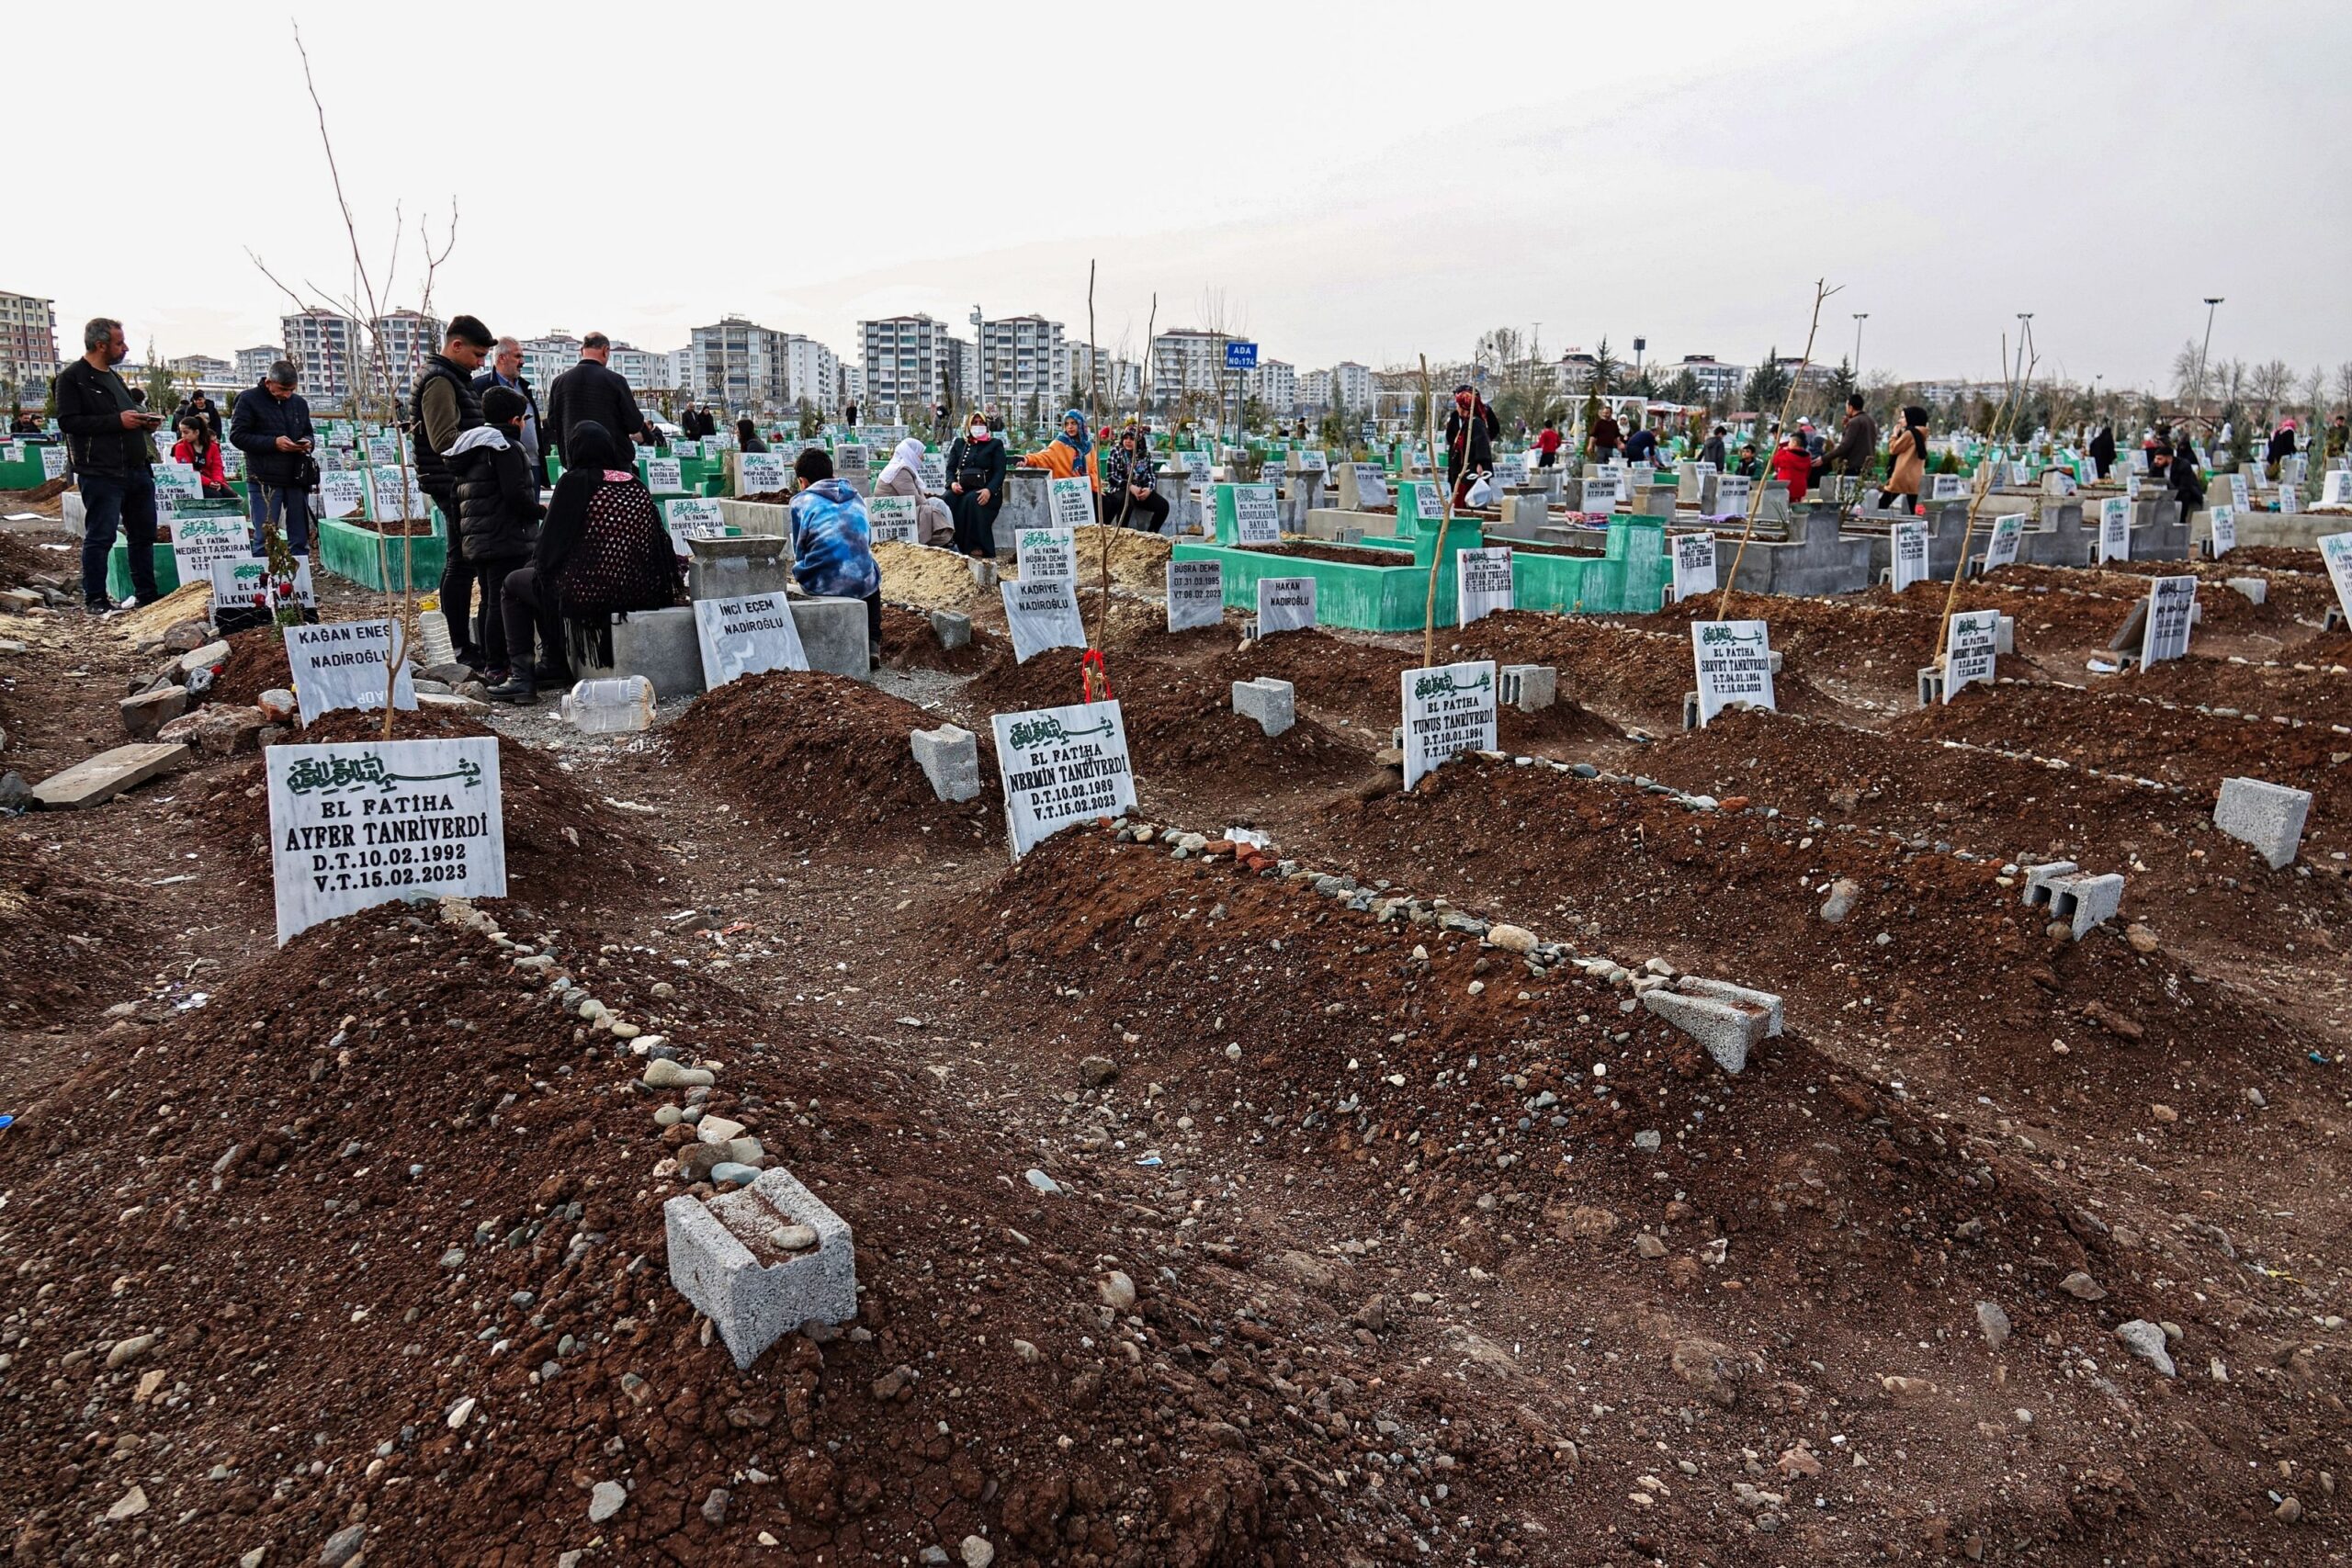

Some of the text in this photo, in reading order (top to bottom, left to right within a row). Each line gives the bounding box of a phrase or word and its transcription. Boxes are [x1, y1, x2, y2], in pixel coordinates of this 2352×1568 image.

[1234, 346, 1251, 355] ADA
[671, 522, 692, 530] ZERİFE
[207, 536, 230, 545] FATİHA
[175, 544, 251, 556] NEDRET TAŞKIRAN
[1025, 554, 1068, 563] BÜŞRA DEMİR
[1174, 563, 1220, 573] BÜŞRA DEMİR
[1021, 582, 1058, 595] KADRİYE
[1275, 582, 1300, 592] HAKAN
[719, 599, 775, 616] İNCİ EÇEM
[1019, 599, 1069, 611] NADİROĞLU
[1270, 596, 1309, 606] NADİROĞLU
[724, 617, 784, 635] NADİROĞLU
[299, 627, 351, 644] KAĞAN
[1713, 647, 1755, 657] EL FATİHA
[1702, 657, 1770, 671] SERVET TANRİVERDİ
[1428, 696, 1479, 713] EL FATİHA
[1413, 707, 1493, 734] YUNUS TANRİVERDİ
[1424, 728, 1483, 746] D.T.10.01.1994
[1031, 743, 1102, 766] EL FATİHA
[1424, 739, 1484, 759] V.T.15.022023
[1009, 754, 1127, 793] NERMİN TANRİVERDİ
[1031, 779, 1114, 806] D.T.10.02.1989
[322, 794, 454, 818] EL FATİHA
[1034, 794, 1116, 821] V.T.15.02.2023
[286, 812, 488, 852] AYFER TANRİVERDİ
[313, 843, 466, 871] D.T.10.02.1992
[314, 864, 467, 892] V.T.15.02.2023
